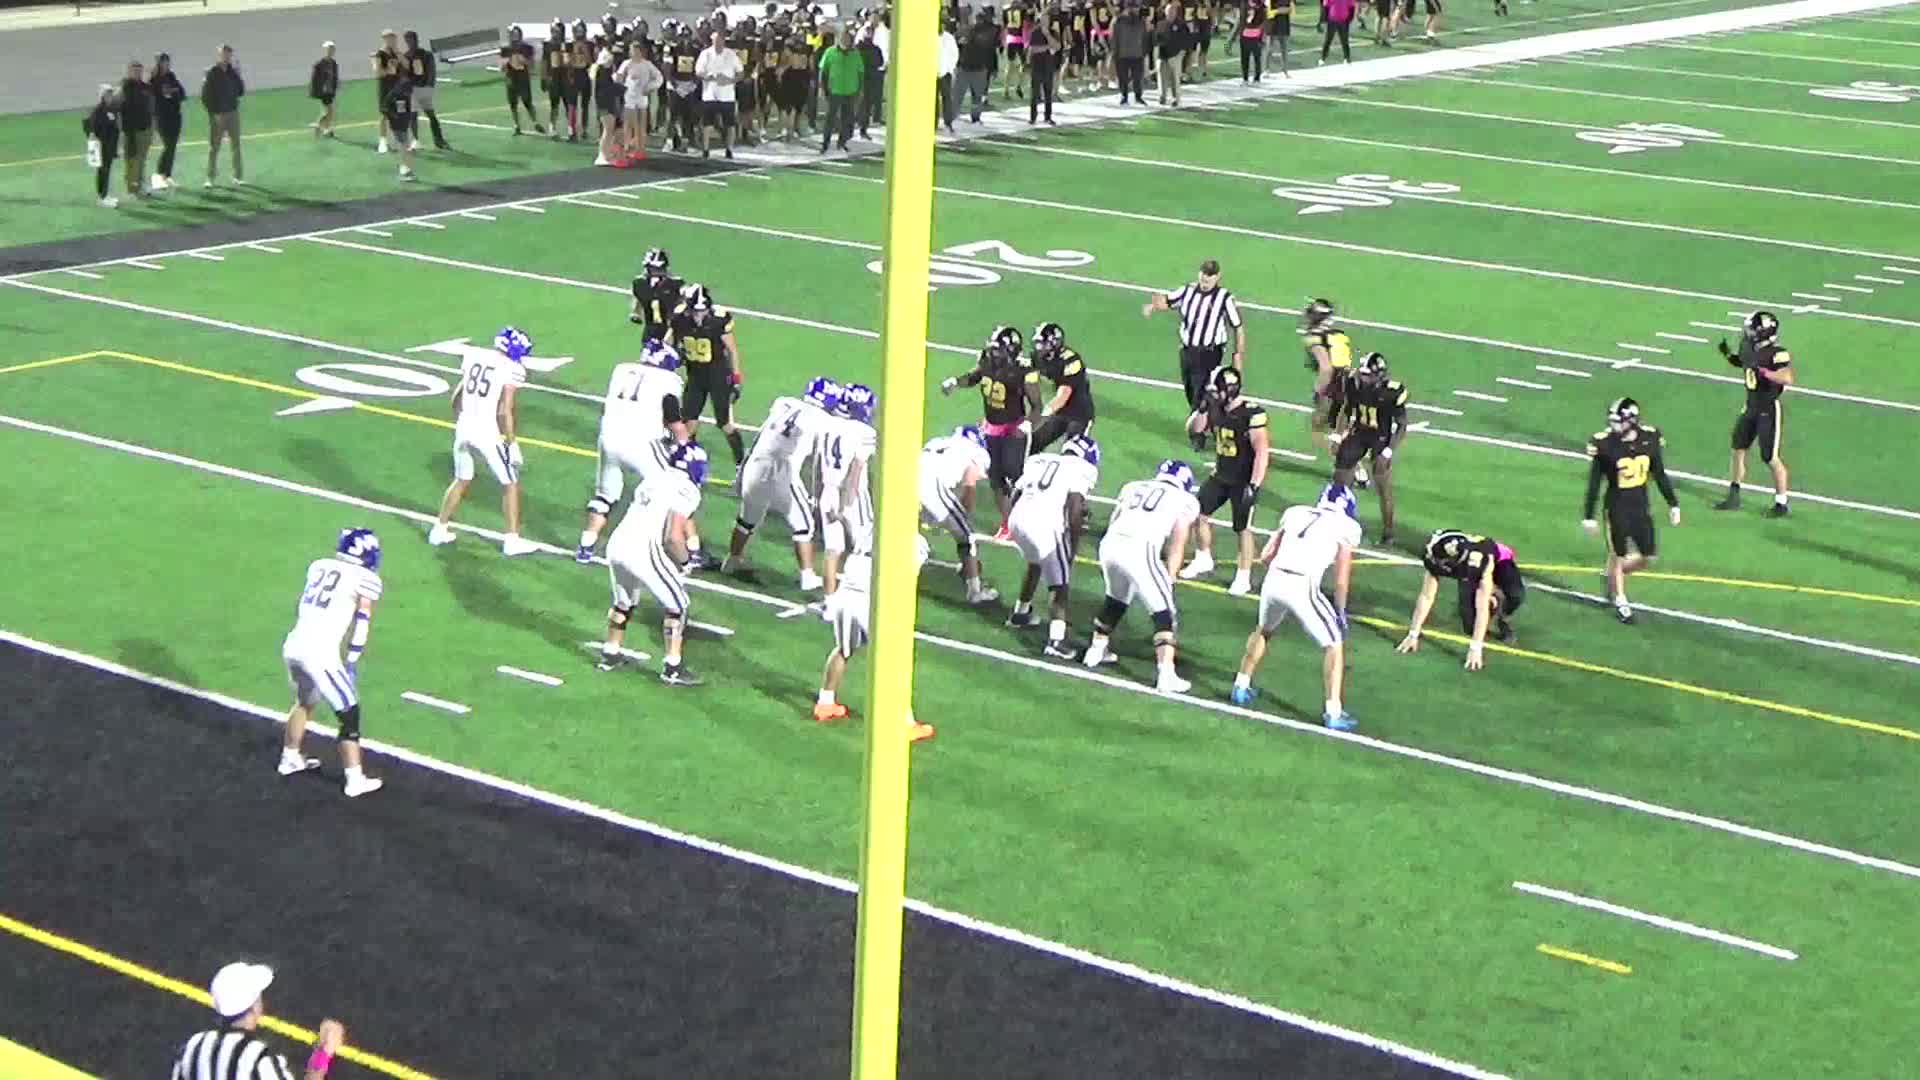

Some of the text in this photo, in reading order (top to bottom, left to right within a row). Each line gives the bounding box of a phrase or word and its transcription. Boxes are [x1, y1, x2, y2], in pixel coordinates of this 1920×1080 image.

[1272, 173, 1461, 207] 30
[465, 363, 495, 397] 85
[1616, 454, 1651, 489] 20
[1297, 510, 1322, 539] 7
[303, 568, 341, 609] 22
